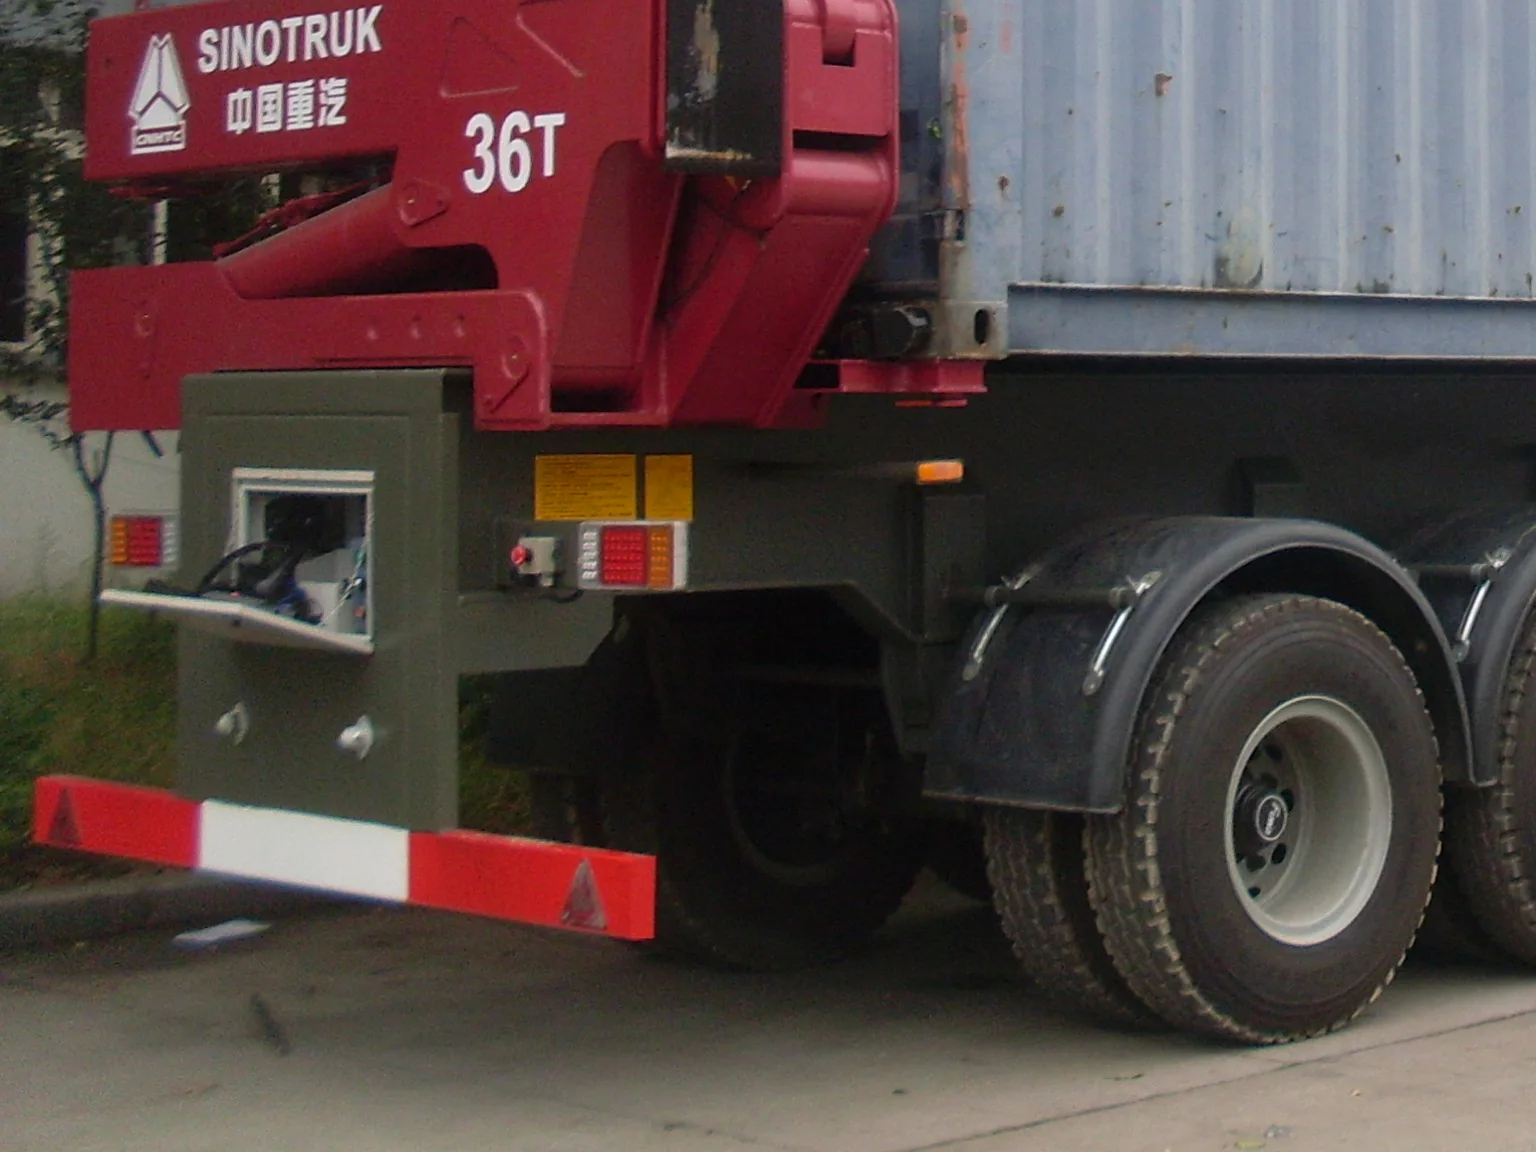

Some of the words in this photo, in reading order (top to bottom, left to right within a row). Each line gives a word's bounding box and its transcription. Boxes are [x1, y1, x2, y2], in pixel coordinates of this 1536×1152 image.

[197, 5, 383, 73] SINOTRUK
[227, 77, 347, 134] 中国重汽
[136, 130, 184, 146] CNHTC
[463, 110, 566, 194] 36T
